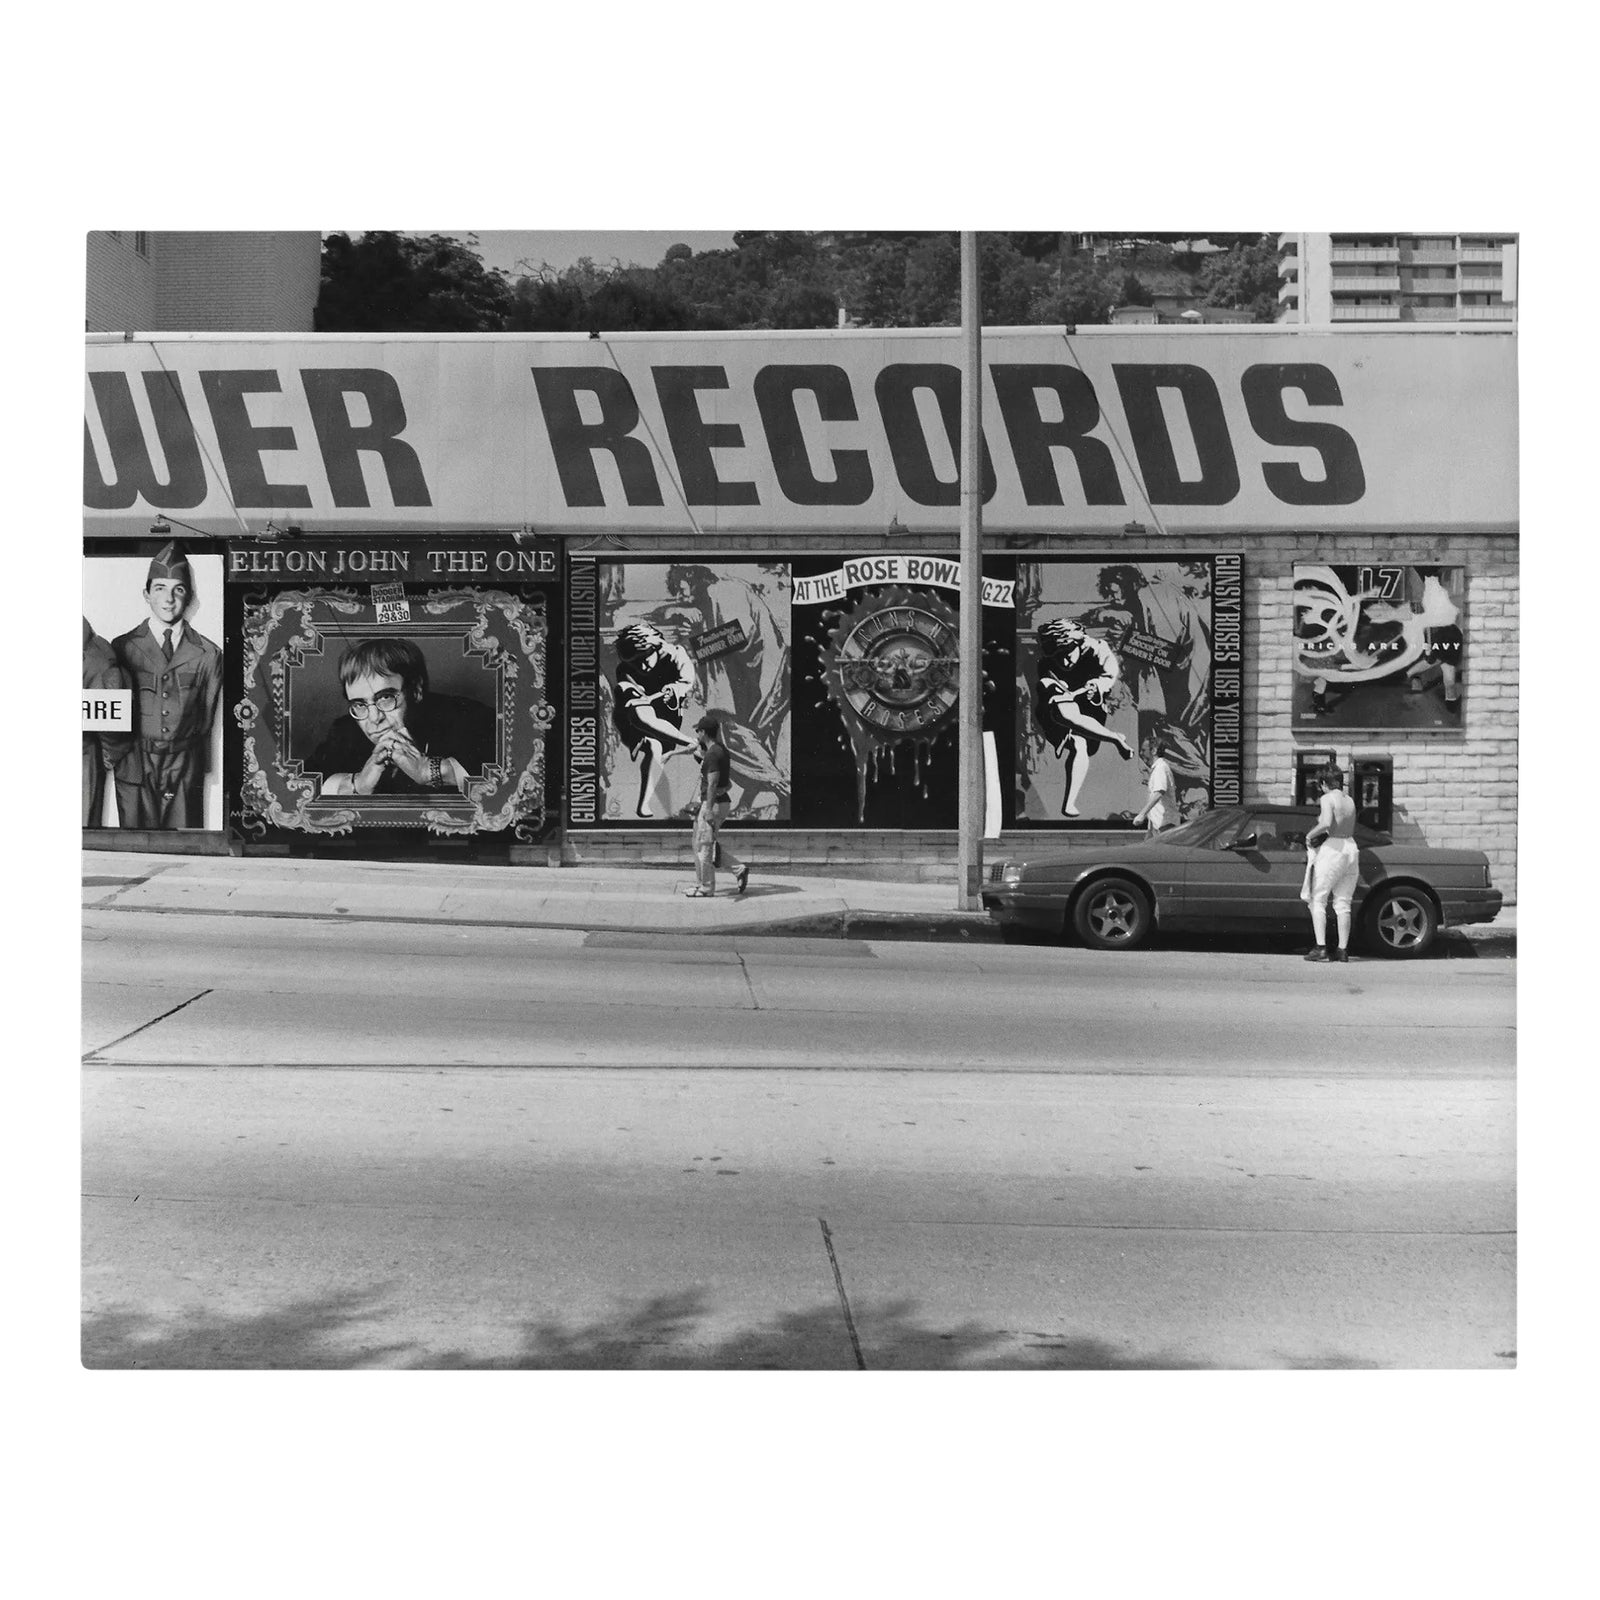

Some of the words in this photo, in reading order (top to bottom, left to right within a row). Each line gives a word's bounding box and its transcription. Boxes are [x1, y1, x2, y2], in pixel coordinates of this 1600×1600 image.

[83, 367, 433, 509] WER
[531, 363, 1367, 506] RECORDS
[230, 550, 327, 572] ELTON
[332, 550, 410, 574] JOHN
[427, 551, 488, 572] THE
[496, 550, 556, 572] ONE
[795, 579, 812, 601] AT
[813, 575, 841, 599] THE
[845, 559, 899, 585] ROSE
[907, 559, 961, 587] BOWL
[378, 610, 410, 622] 29&30
[381, 602, 405, 613] AUG.
[570, 564, 596, 632] ILLUSION
[570, 635, 596, 677] YOUR
[1214, 612, 1241, 662] ROSES
[1298, 642, 1358, 651] BRICKS
[1368, 642, 1399, 651] ARE
[1411, 642, 1461, 651] HEAVY
[570, 681, 596, 710] USE
[1214, 668, 1240, 698] USE
[570, 717, 596, 767] ROSES
[1214, 702, 1240, 743] YOUR
[1214, 747, 1240, 807] ILLUSIO
